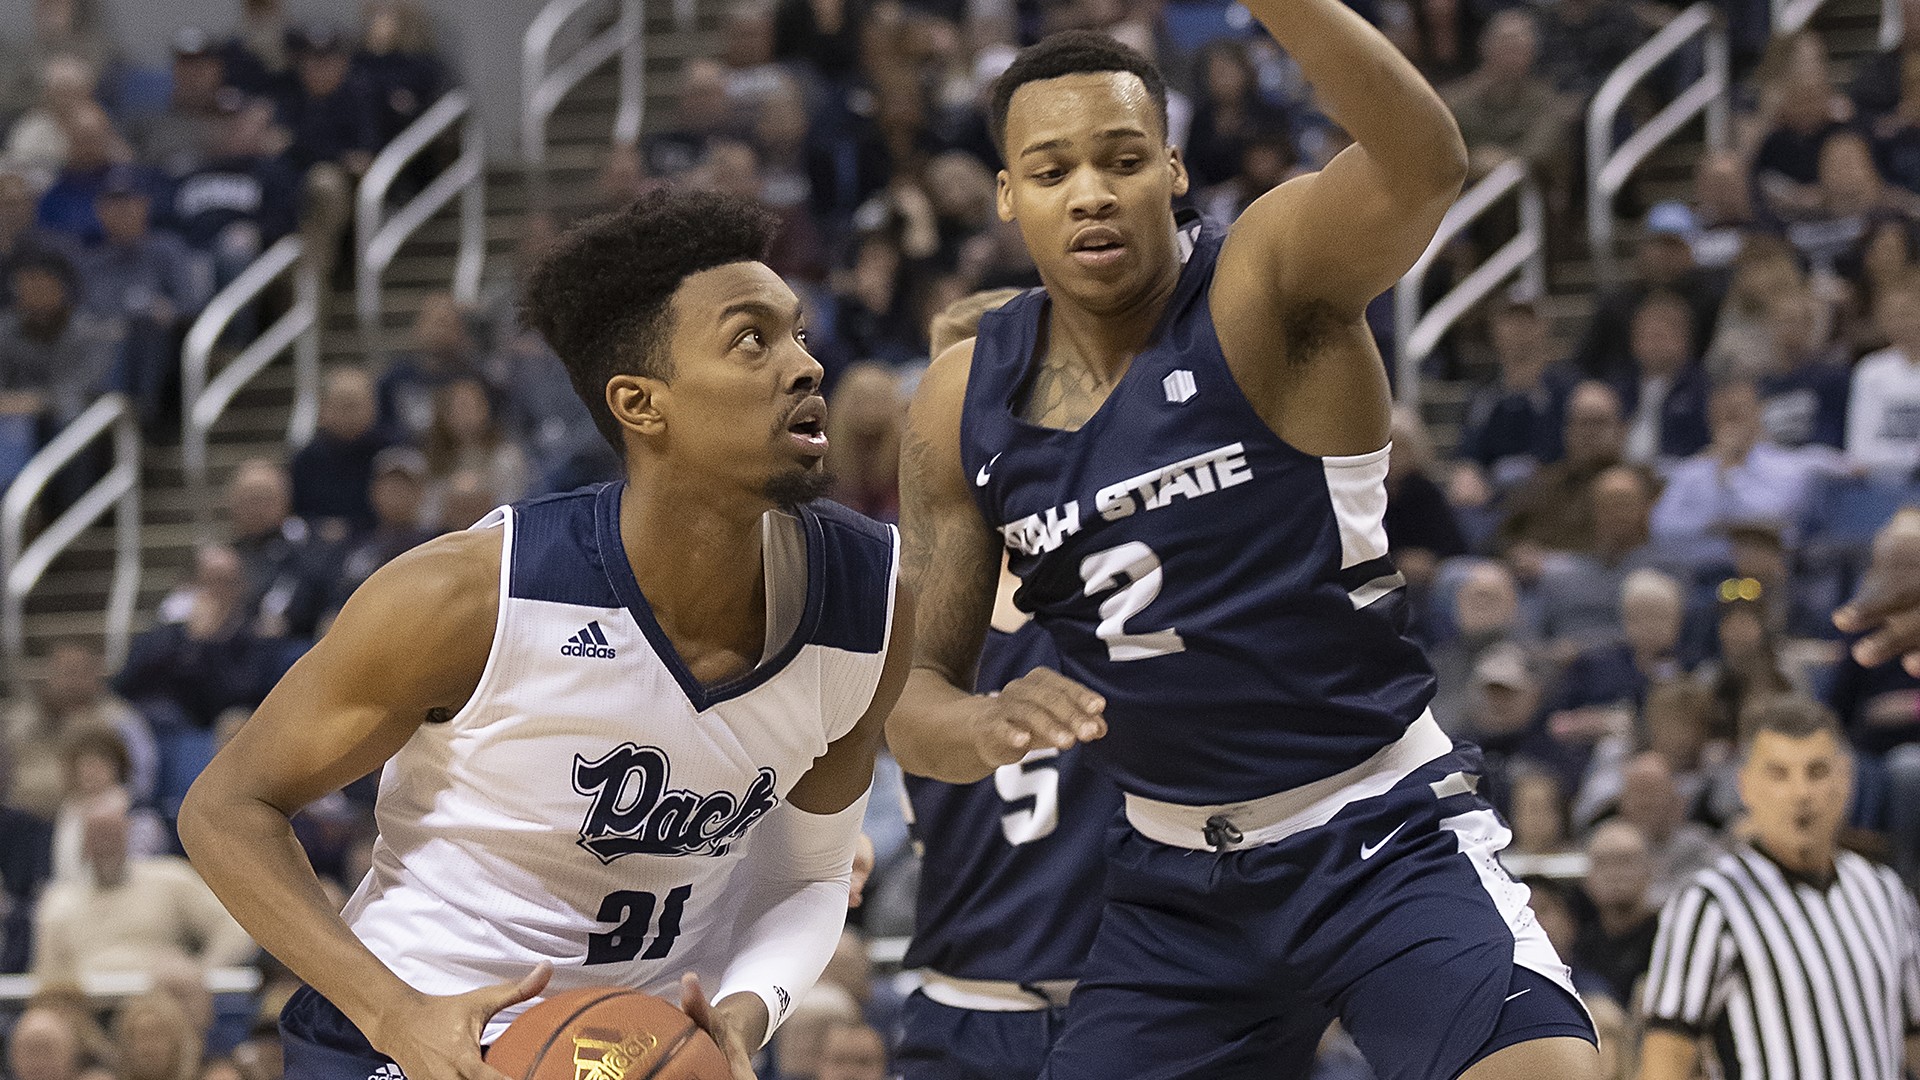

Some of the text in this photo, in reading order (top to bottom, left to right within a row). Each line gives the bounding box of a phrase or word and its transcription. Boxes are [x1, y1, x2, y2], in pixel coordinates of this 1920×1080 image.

[1095, 441, 1253, 522] STATE
[1079, 540, 1186, 662] 2
[560, 643, 616, 659] adidas
[571, 741, 779, 865] Pack
[995, 747, 1059, 846] 5
